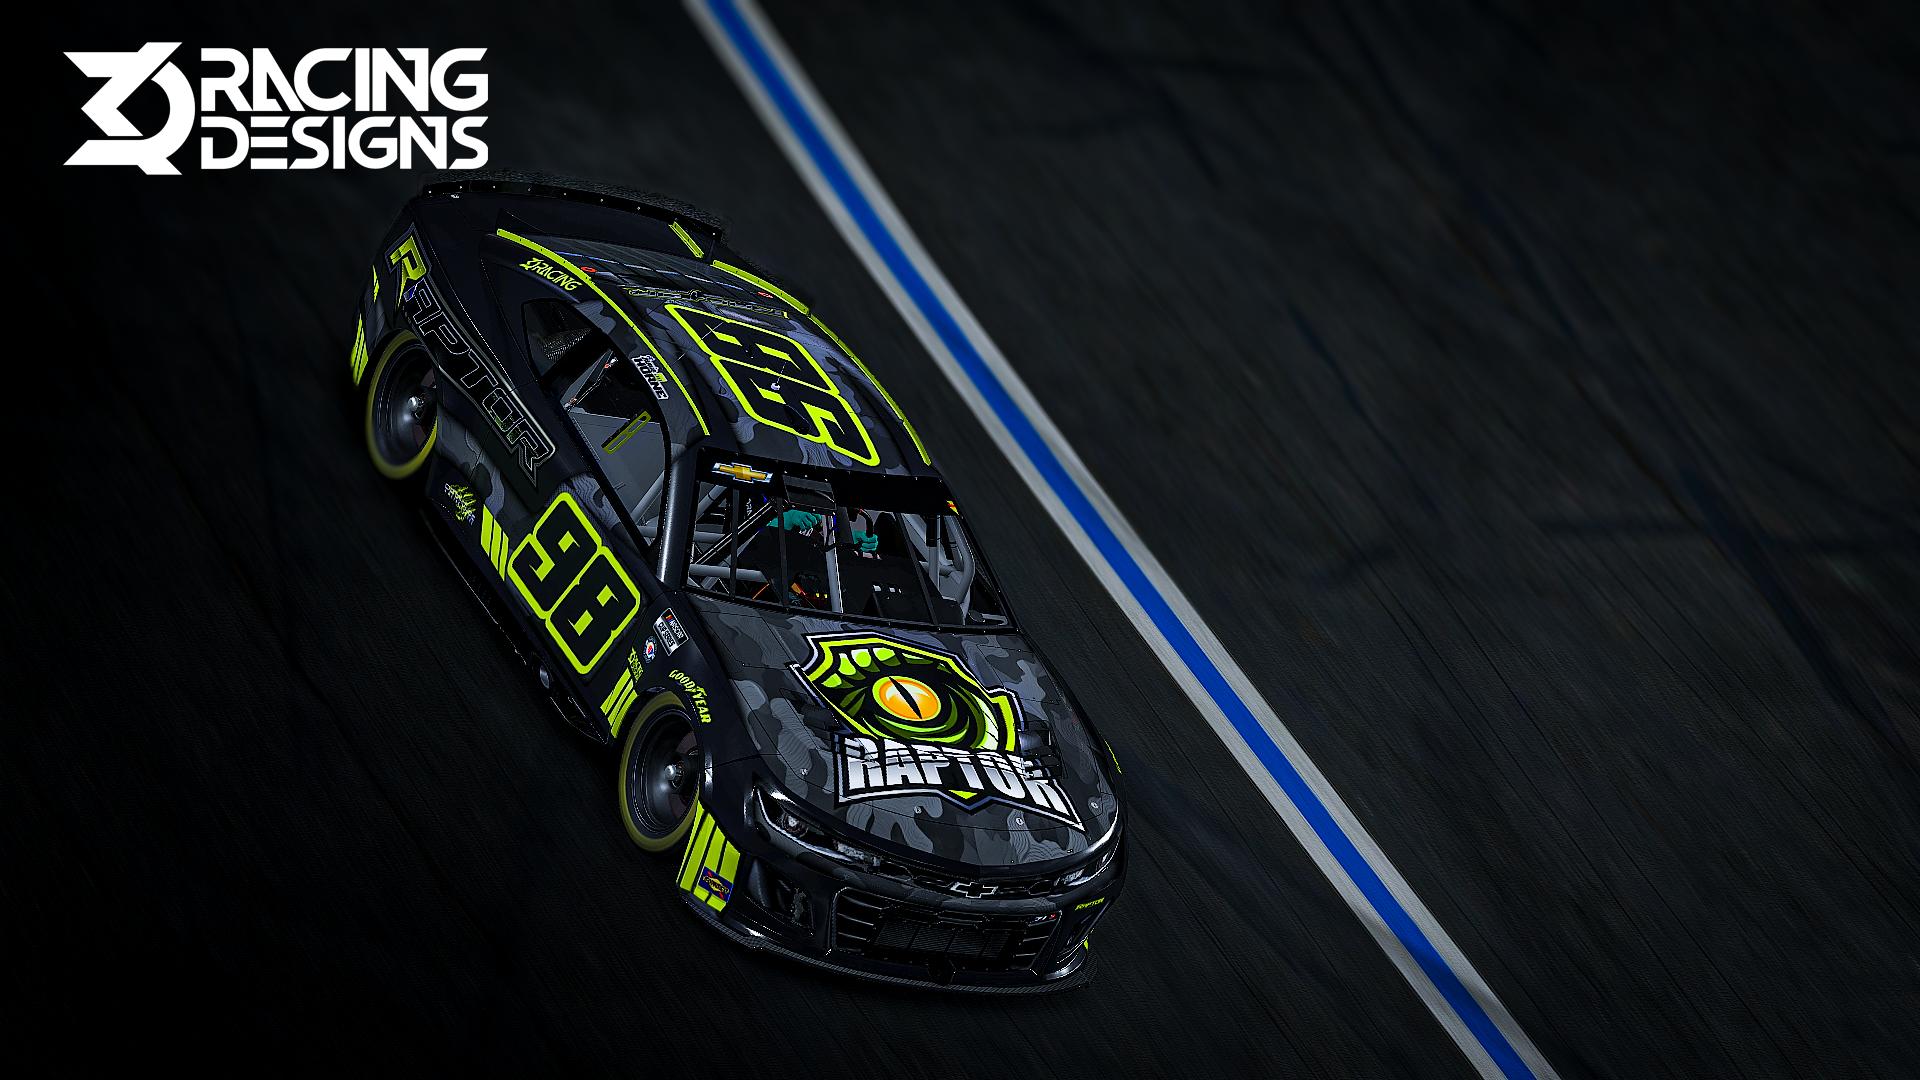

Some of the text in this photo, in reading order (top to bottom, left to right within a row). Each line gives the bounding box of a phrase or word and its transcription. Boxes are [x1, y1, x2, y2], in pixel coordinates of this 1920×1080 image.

[389, 235, 551, 473] RAPTOR
[507, 491, 641, 675] 98
[668, 669, 712, 724] GOODYEAR
[843, 737, 1071, 817] RAPTOR
